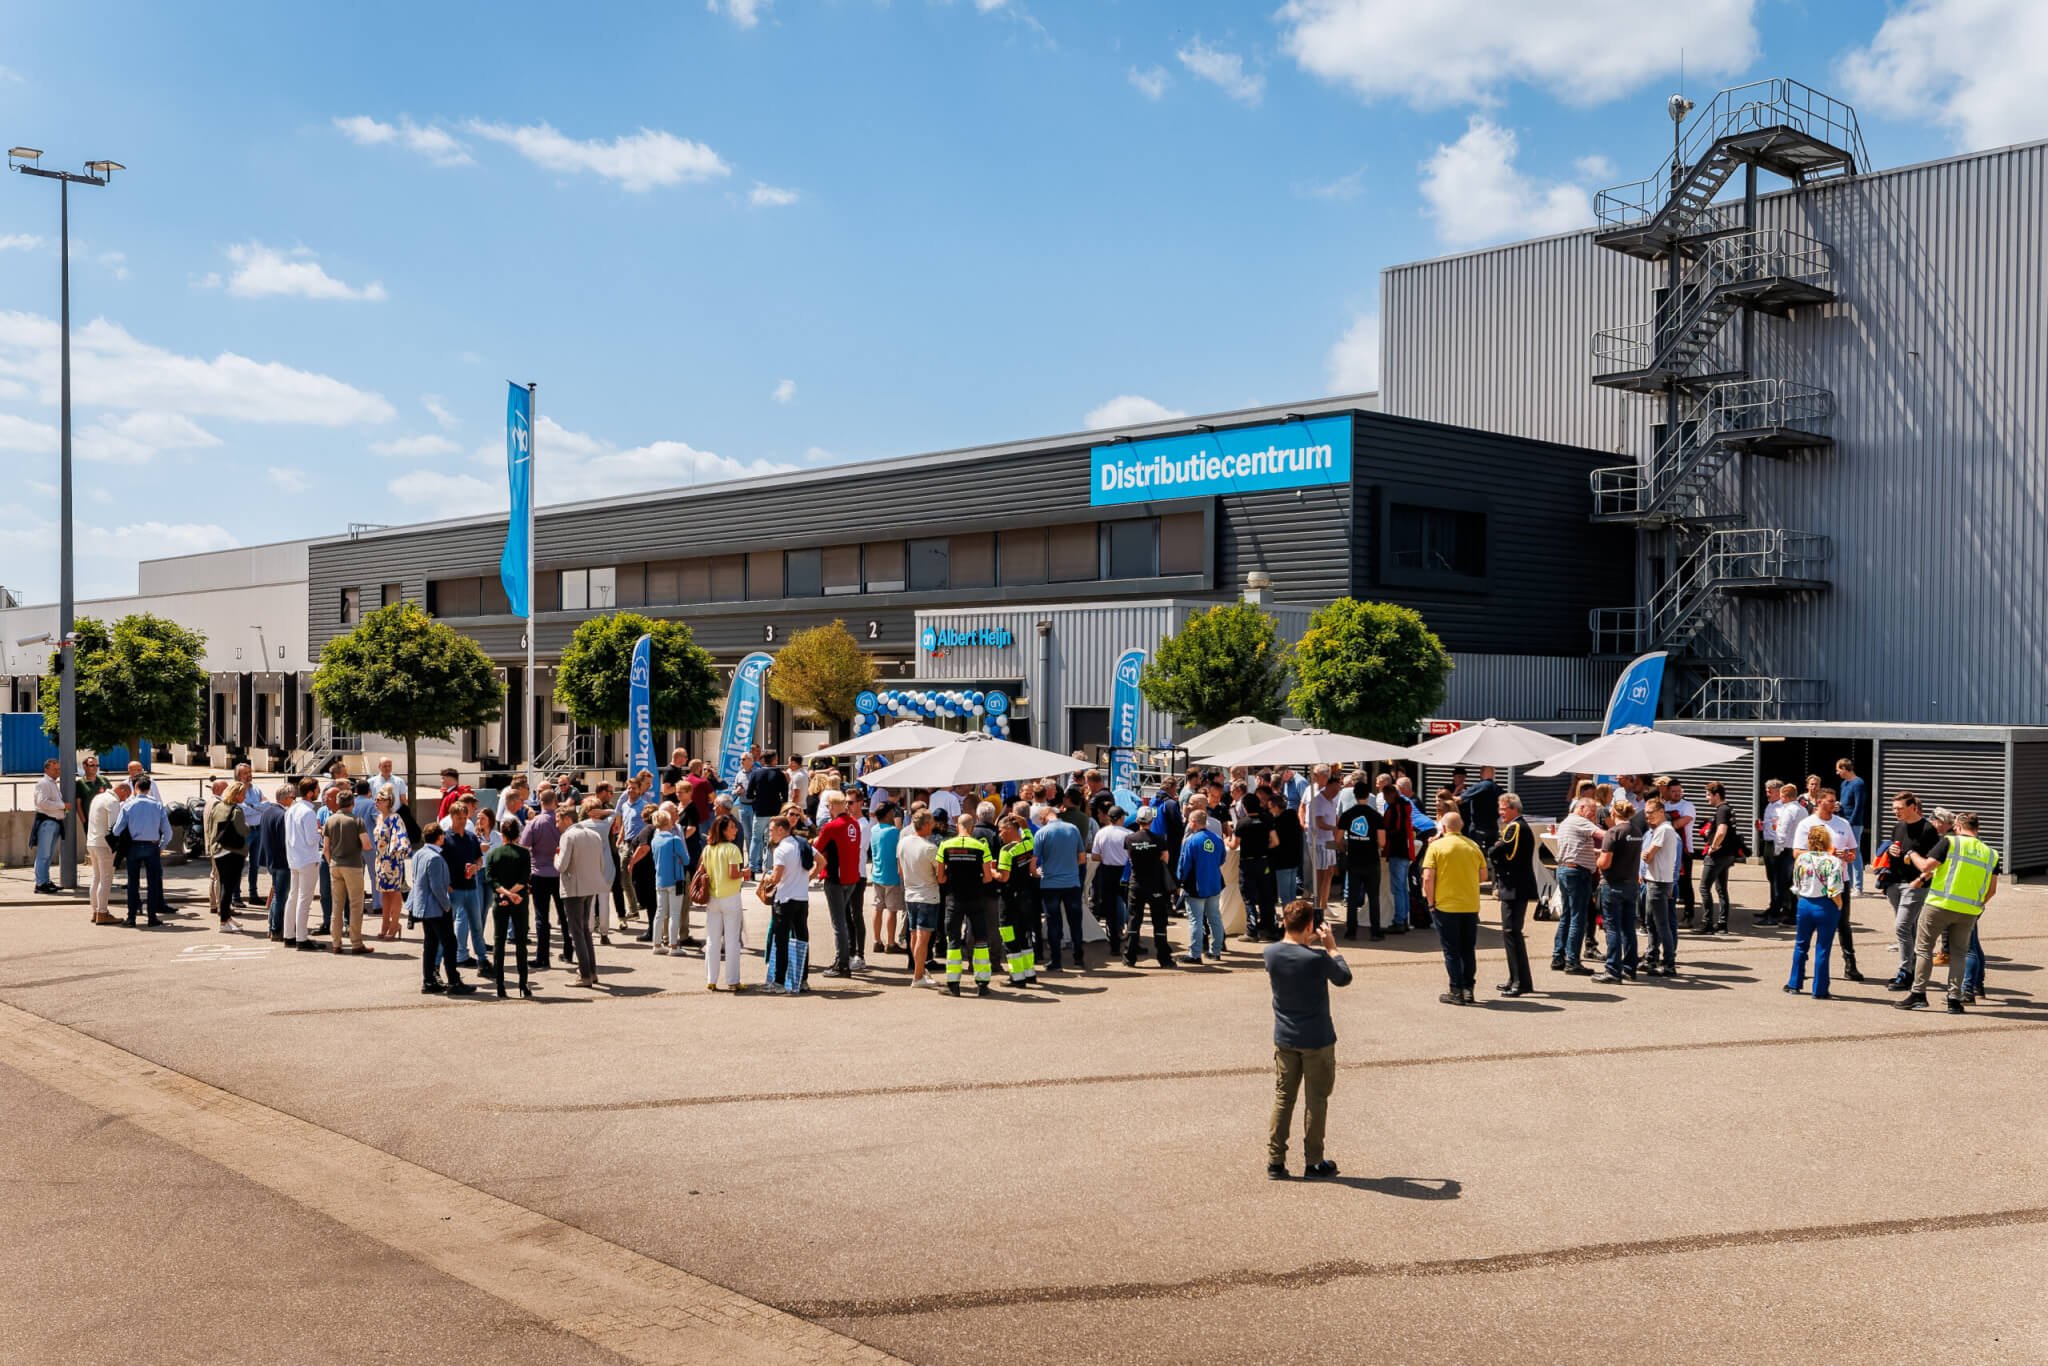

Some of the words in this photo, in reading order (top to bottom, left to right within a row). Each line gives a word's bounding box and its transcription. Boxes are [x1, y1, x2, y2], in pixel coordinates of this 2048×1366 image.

[1101, 444, 1332, 491] Distributiecentrum
[766, 625, 773, 641] 3
[869, 621, 878, 638] 2
[937, 627, 976, 648] Albert
[979, 627, 1012, 649] Heijn
[521, 634, 527, 649] 6
